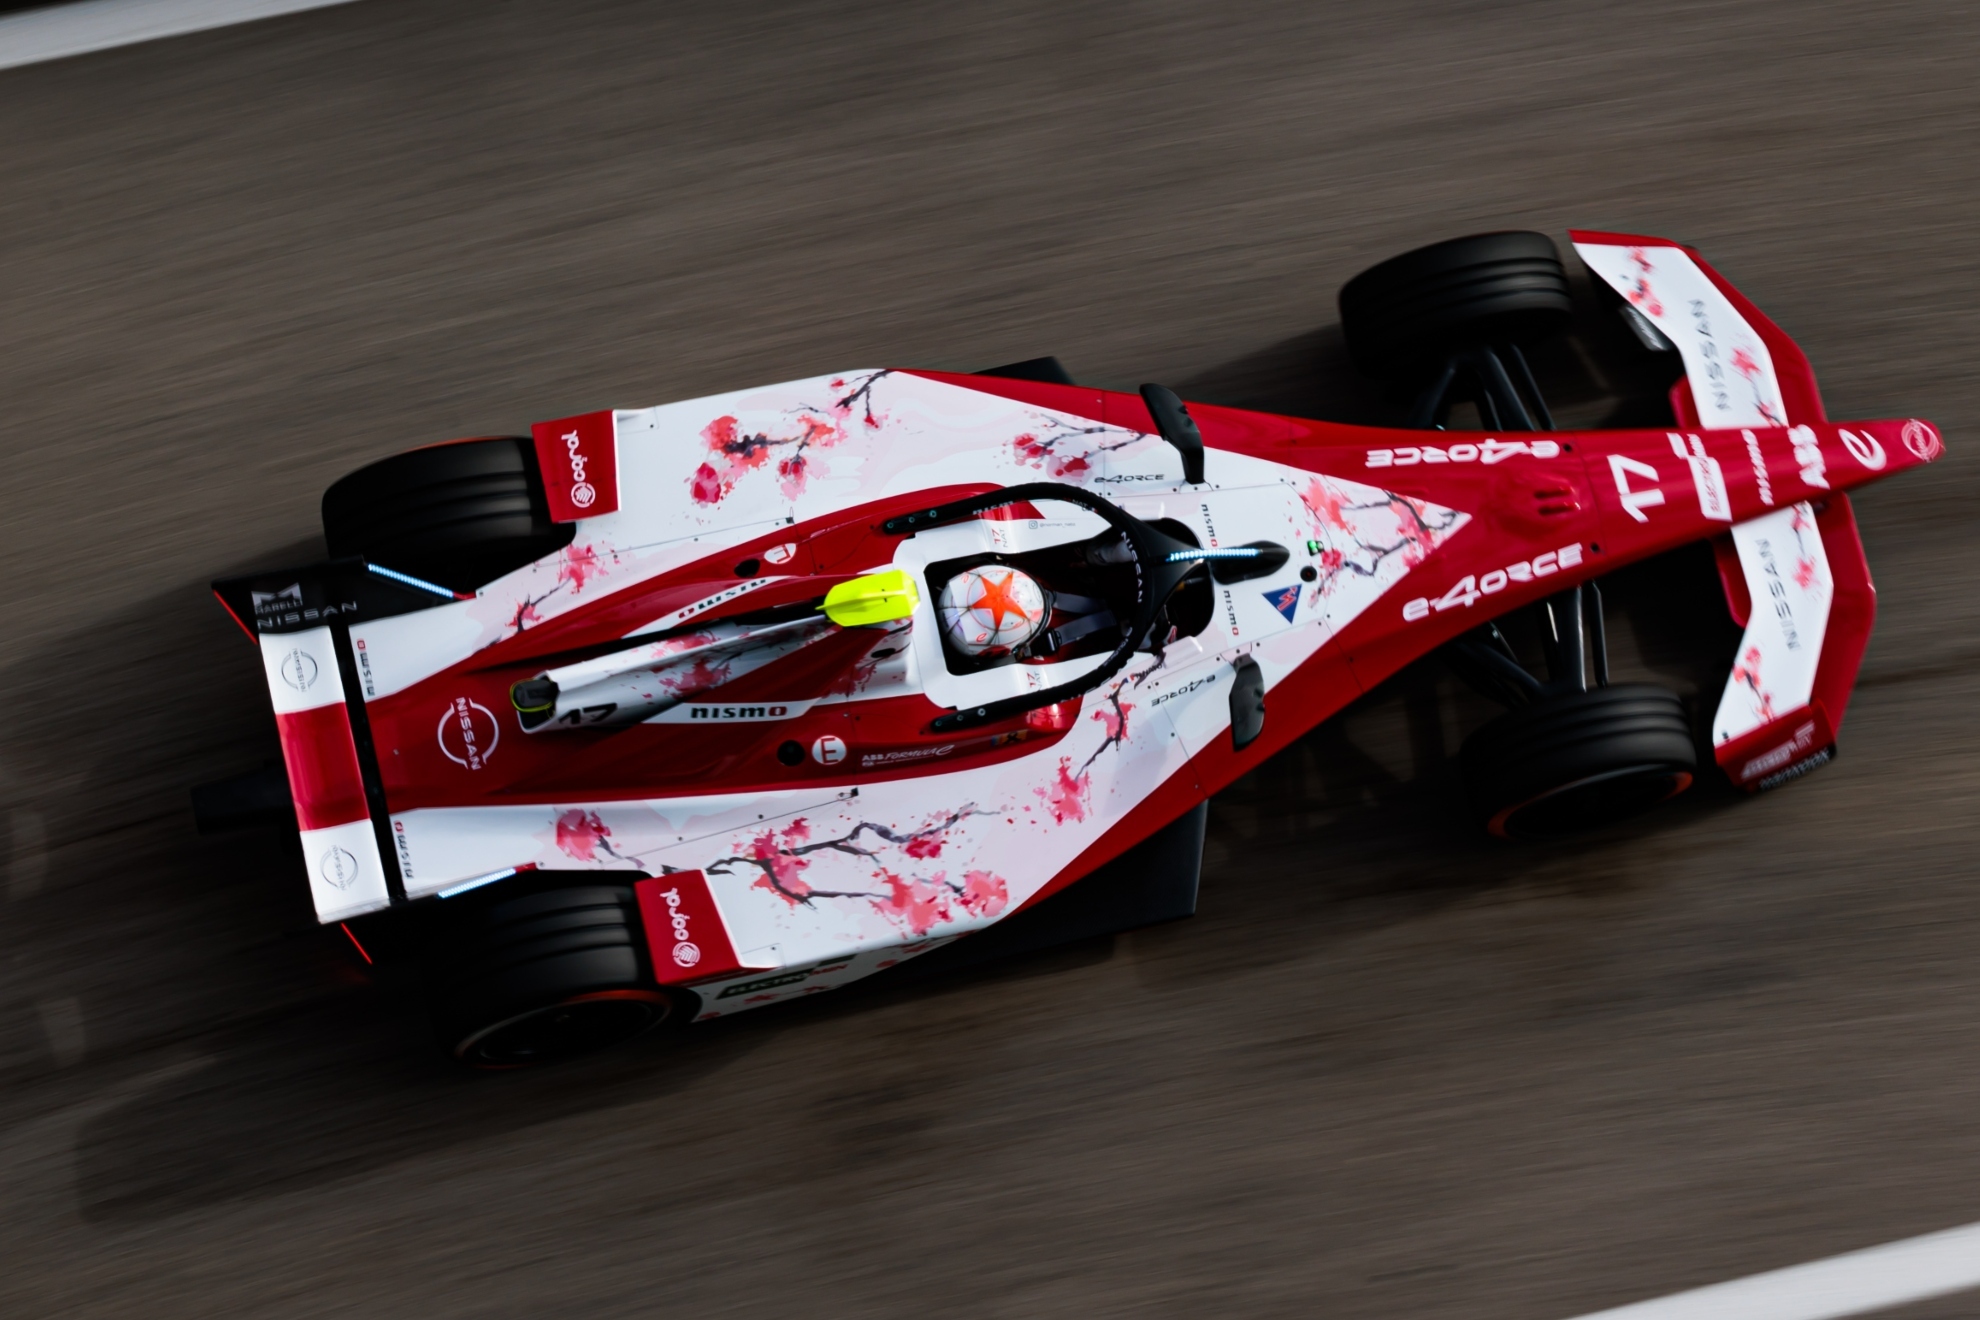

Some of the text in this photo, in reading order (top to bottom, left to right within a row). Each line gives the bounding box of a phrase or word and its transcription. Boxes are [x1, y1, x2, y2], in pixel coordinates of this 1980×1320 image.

[1687, 298, 1731, 410] NISSAN
[1787, 423, 1830, 490] ABB
[1606, 453, 1666, 524] 17
[992, 528, 1001, 545] 17
[999, 528, 1009, 548] NAT
[1201, 503, 1218, 547] nismo
[1120, 531, 1143, 602] NISSAN
[257, 600, 357, 630] NISSAN
[1223, 590, 1239, 636] nismo
[1755, 538, 1801, 651] NISSAN
[356, 639, 375, 696] nismo
[1027, 672, 1036, 688] 17
[456, 697, 481, 770] NISSAN
[558, 702, 618, 725] 17
[691, 707, 787, 719] nismo
